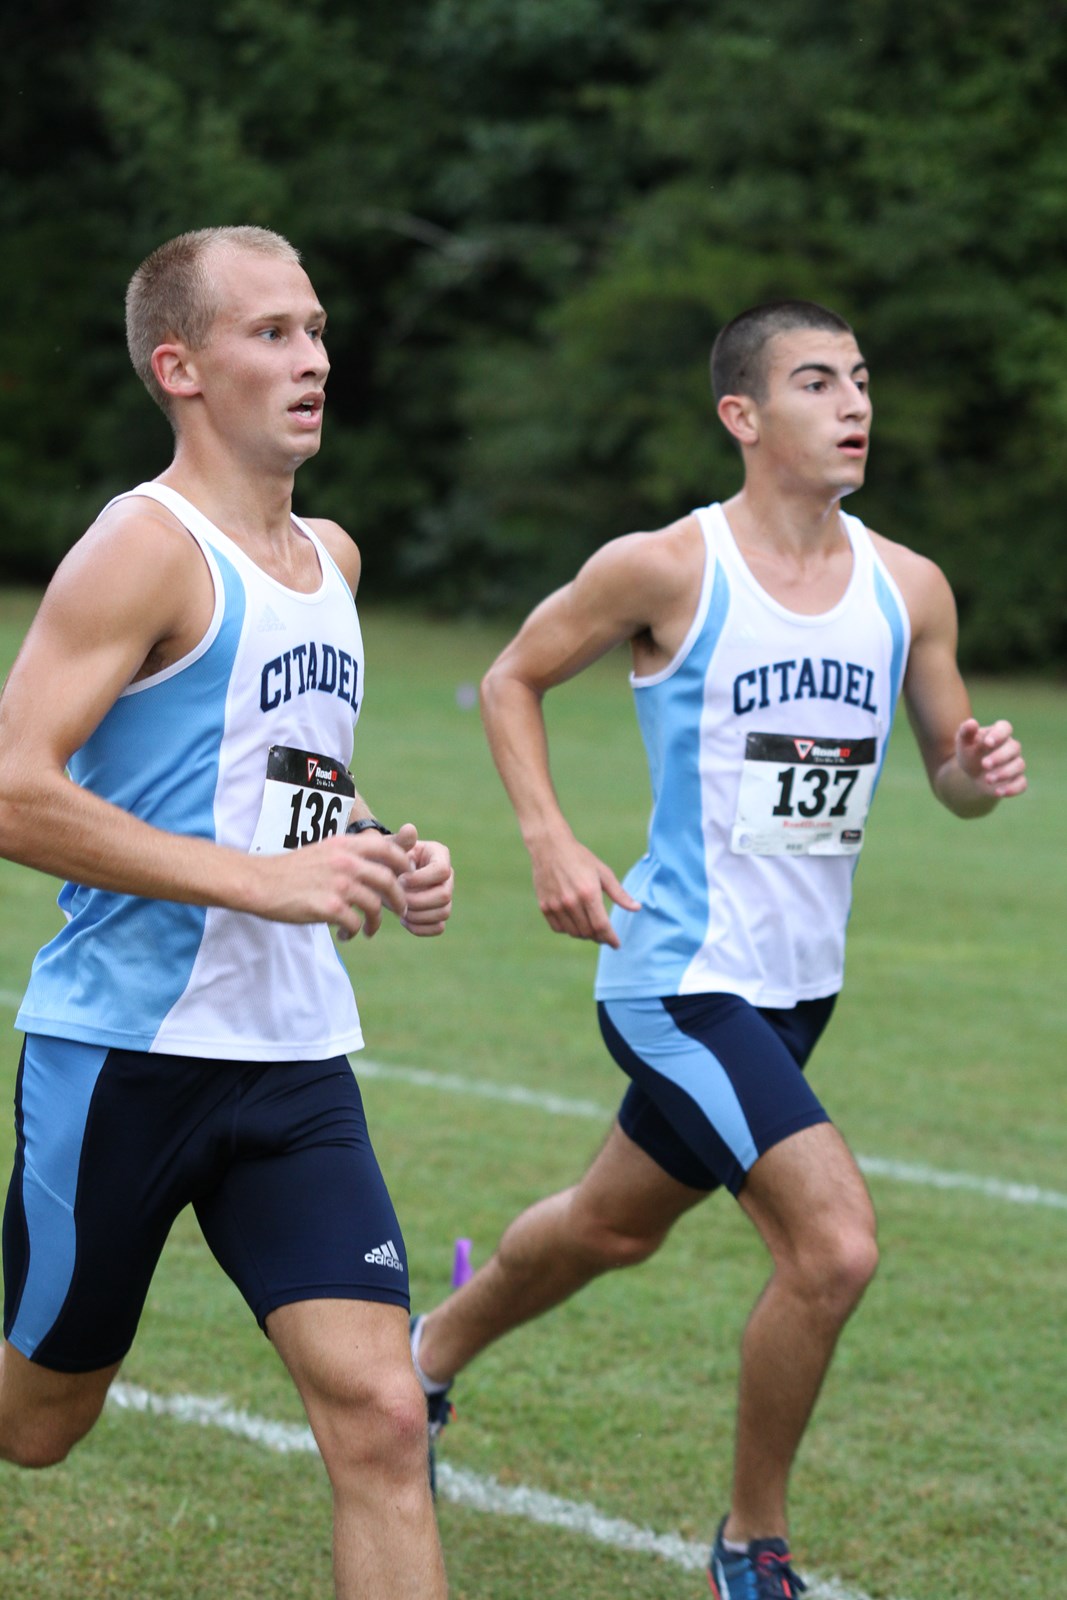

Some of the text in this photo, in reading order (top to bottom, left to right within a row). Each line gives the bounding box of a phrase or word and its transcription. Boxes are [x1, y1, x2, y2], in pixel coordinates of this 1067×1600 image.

[260, 641, 359, 713] CITADEL
[733, 658, 878, 716] CITADEL
[283, 788, 343, 851] 136
[772, 767, 860, 818] 137
[364, 1252, 404, 1273] adidas
